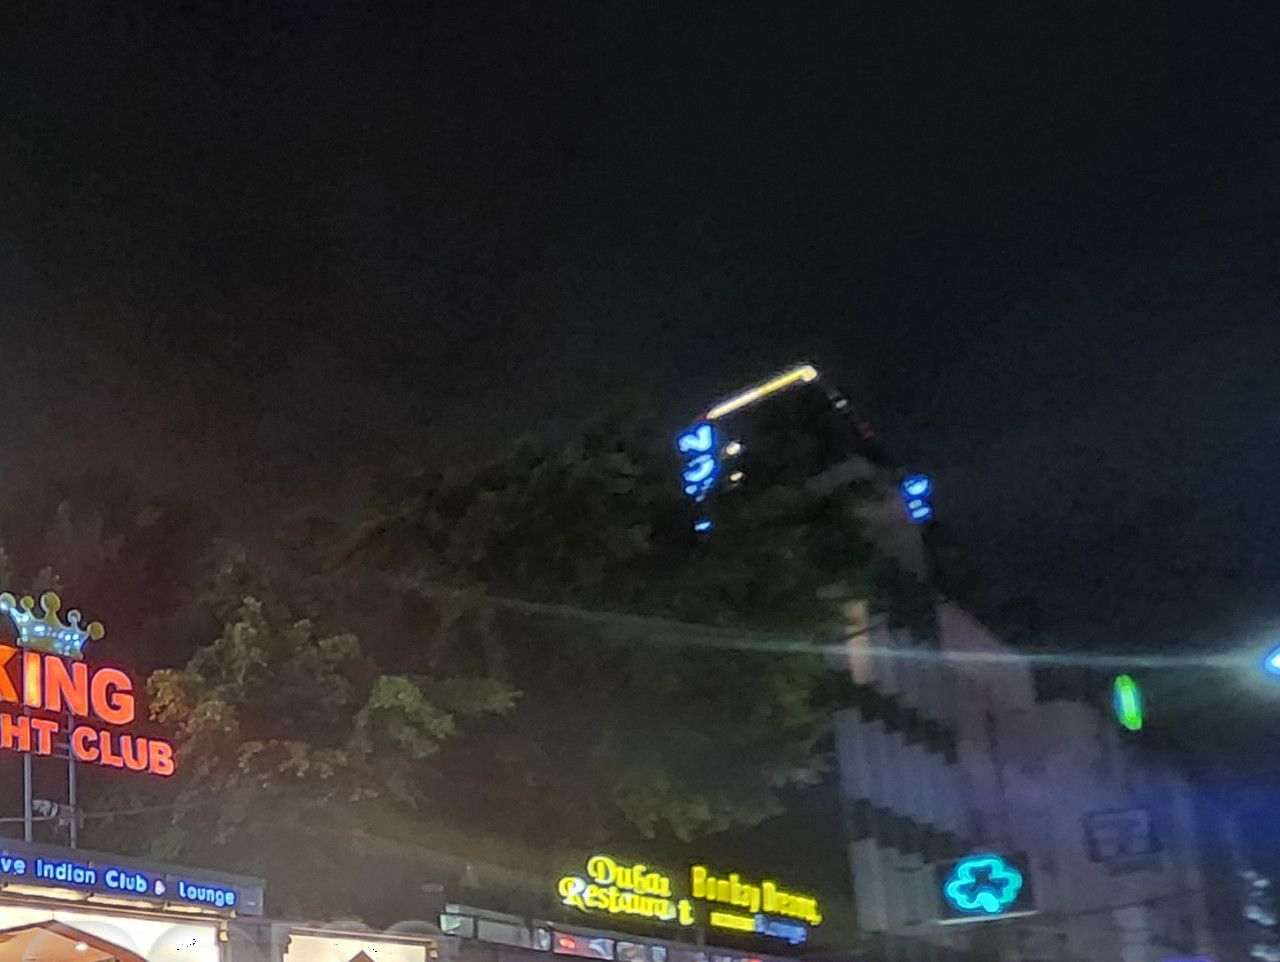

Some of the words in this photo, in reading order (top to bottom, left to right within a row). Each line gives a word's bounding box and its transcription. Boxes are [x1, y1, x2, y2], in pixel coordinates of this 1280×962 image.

[71, 726, 176, 777] CLUB
[36, 858, 96, 886] Indian
[105, 869, 148, 895] Club
[178, 880, 236, 908] Lounge
